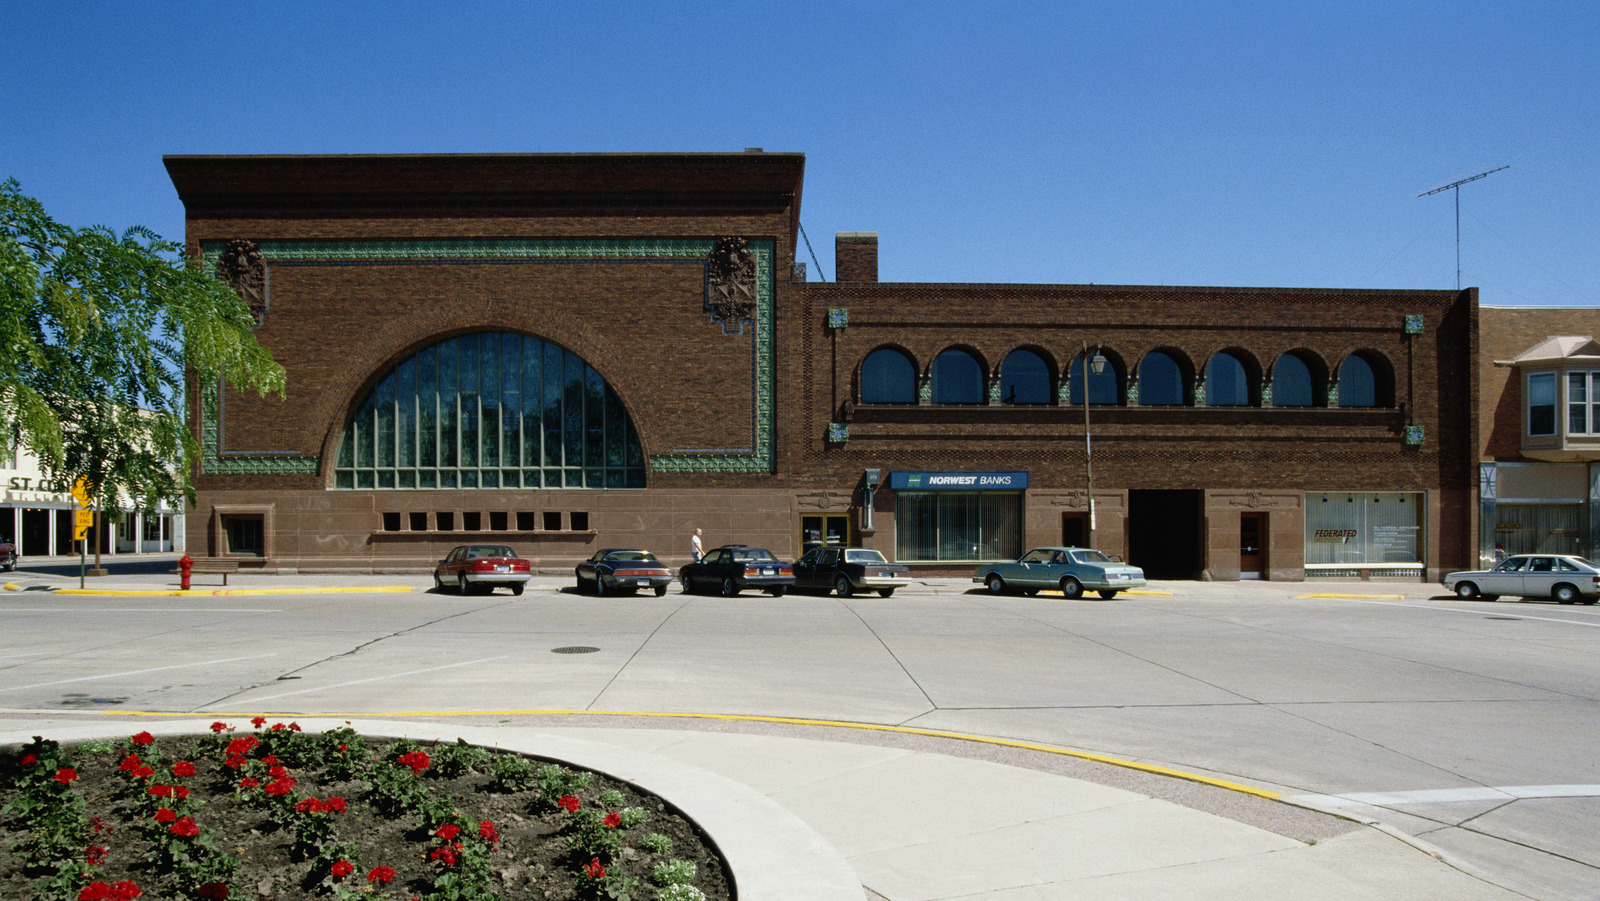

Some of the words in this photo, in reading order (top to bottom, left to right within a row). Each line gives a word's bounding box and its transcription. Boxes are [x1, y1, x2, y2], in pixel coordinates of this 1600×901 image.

[10, 477, 33, 491] ST.
[929, 476, 977, 485] NORWEST
[980, 476, 1011, 485] BANKS
[1315, 529, 1358, 538] FEDERATED
